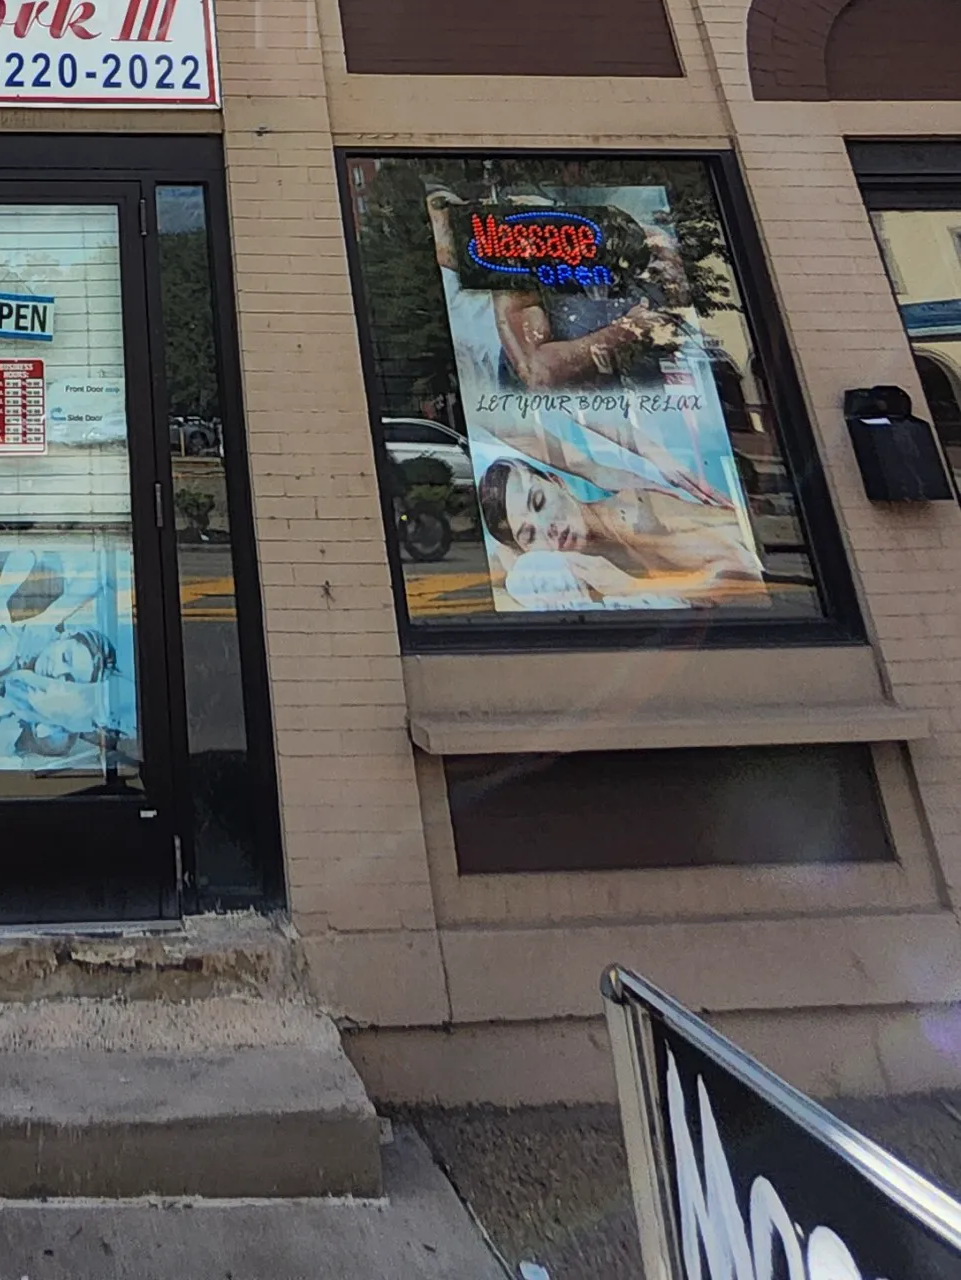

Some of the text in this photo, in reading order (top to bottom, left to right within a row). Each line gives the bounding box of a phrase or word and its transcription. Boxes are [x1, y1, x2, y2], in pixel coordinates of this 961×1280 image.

[471, 213, 597, 266] Massage
[65, 385, 104, 393] Front Door
[475, 394, 703, 419] LET YOUR BODY RELAX
[67, 414, 103, 422] Side Door
